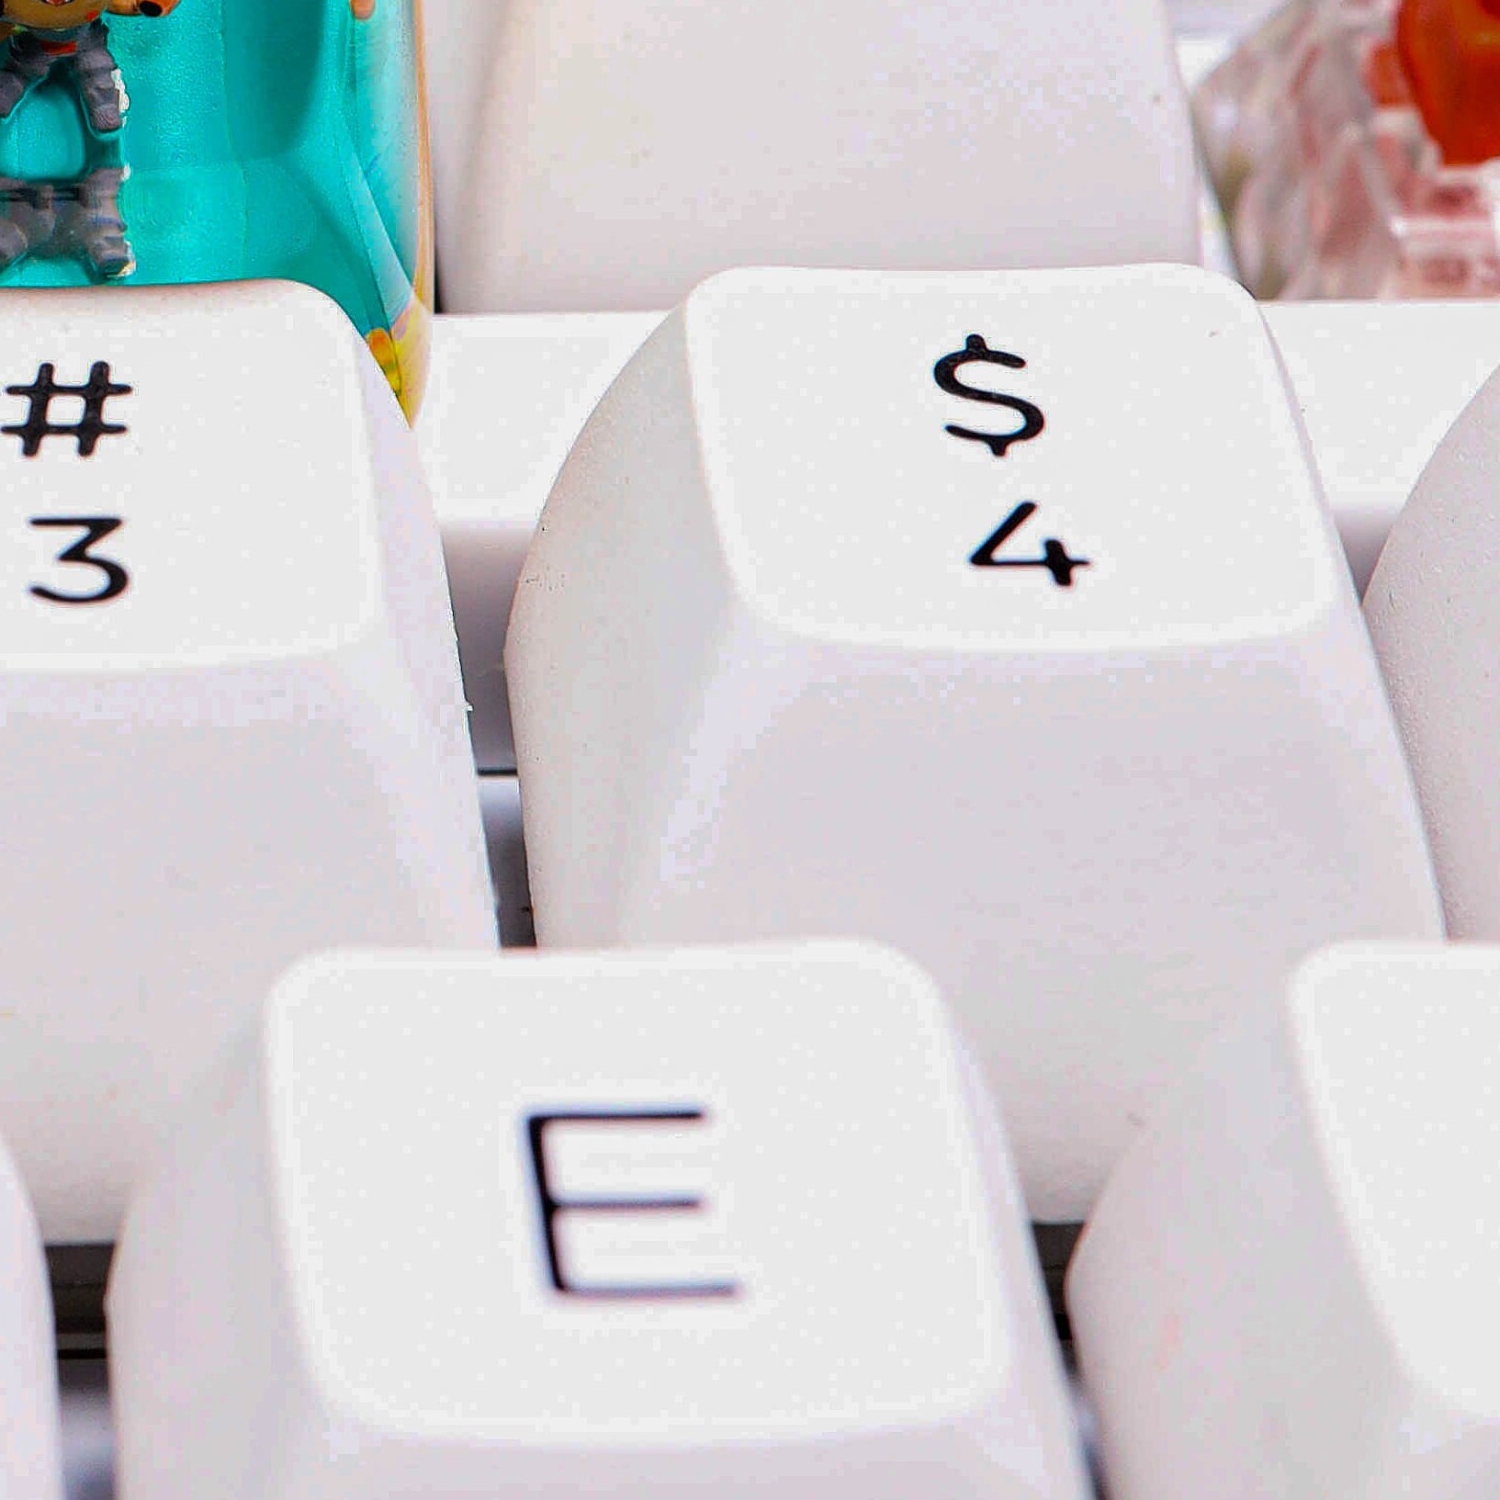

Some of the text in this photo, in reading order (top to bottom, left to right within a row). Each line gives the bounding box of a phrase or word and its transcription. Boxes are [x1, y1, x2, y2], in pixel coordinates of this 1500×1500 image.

[0, 360, 133, 458] #
[932, 333, 1046, 458] $
[29, 515, 129, 605] 3
[968, 501, 1091, 588] 4
[522, 1106, 737, 1298] E
